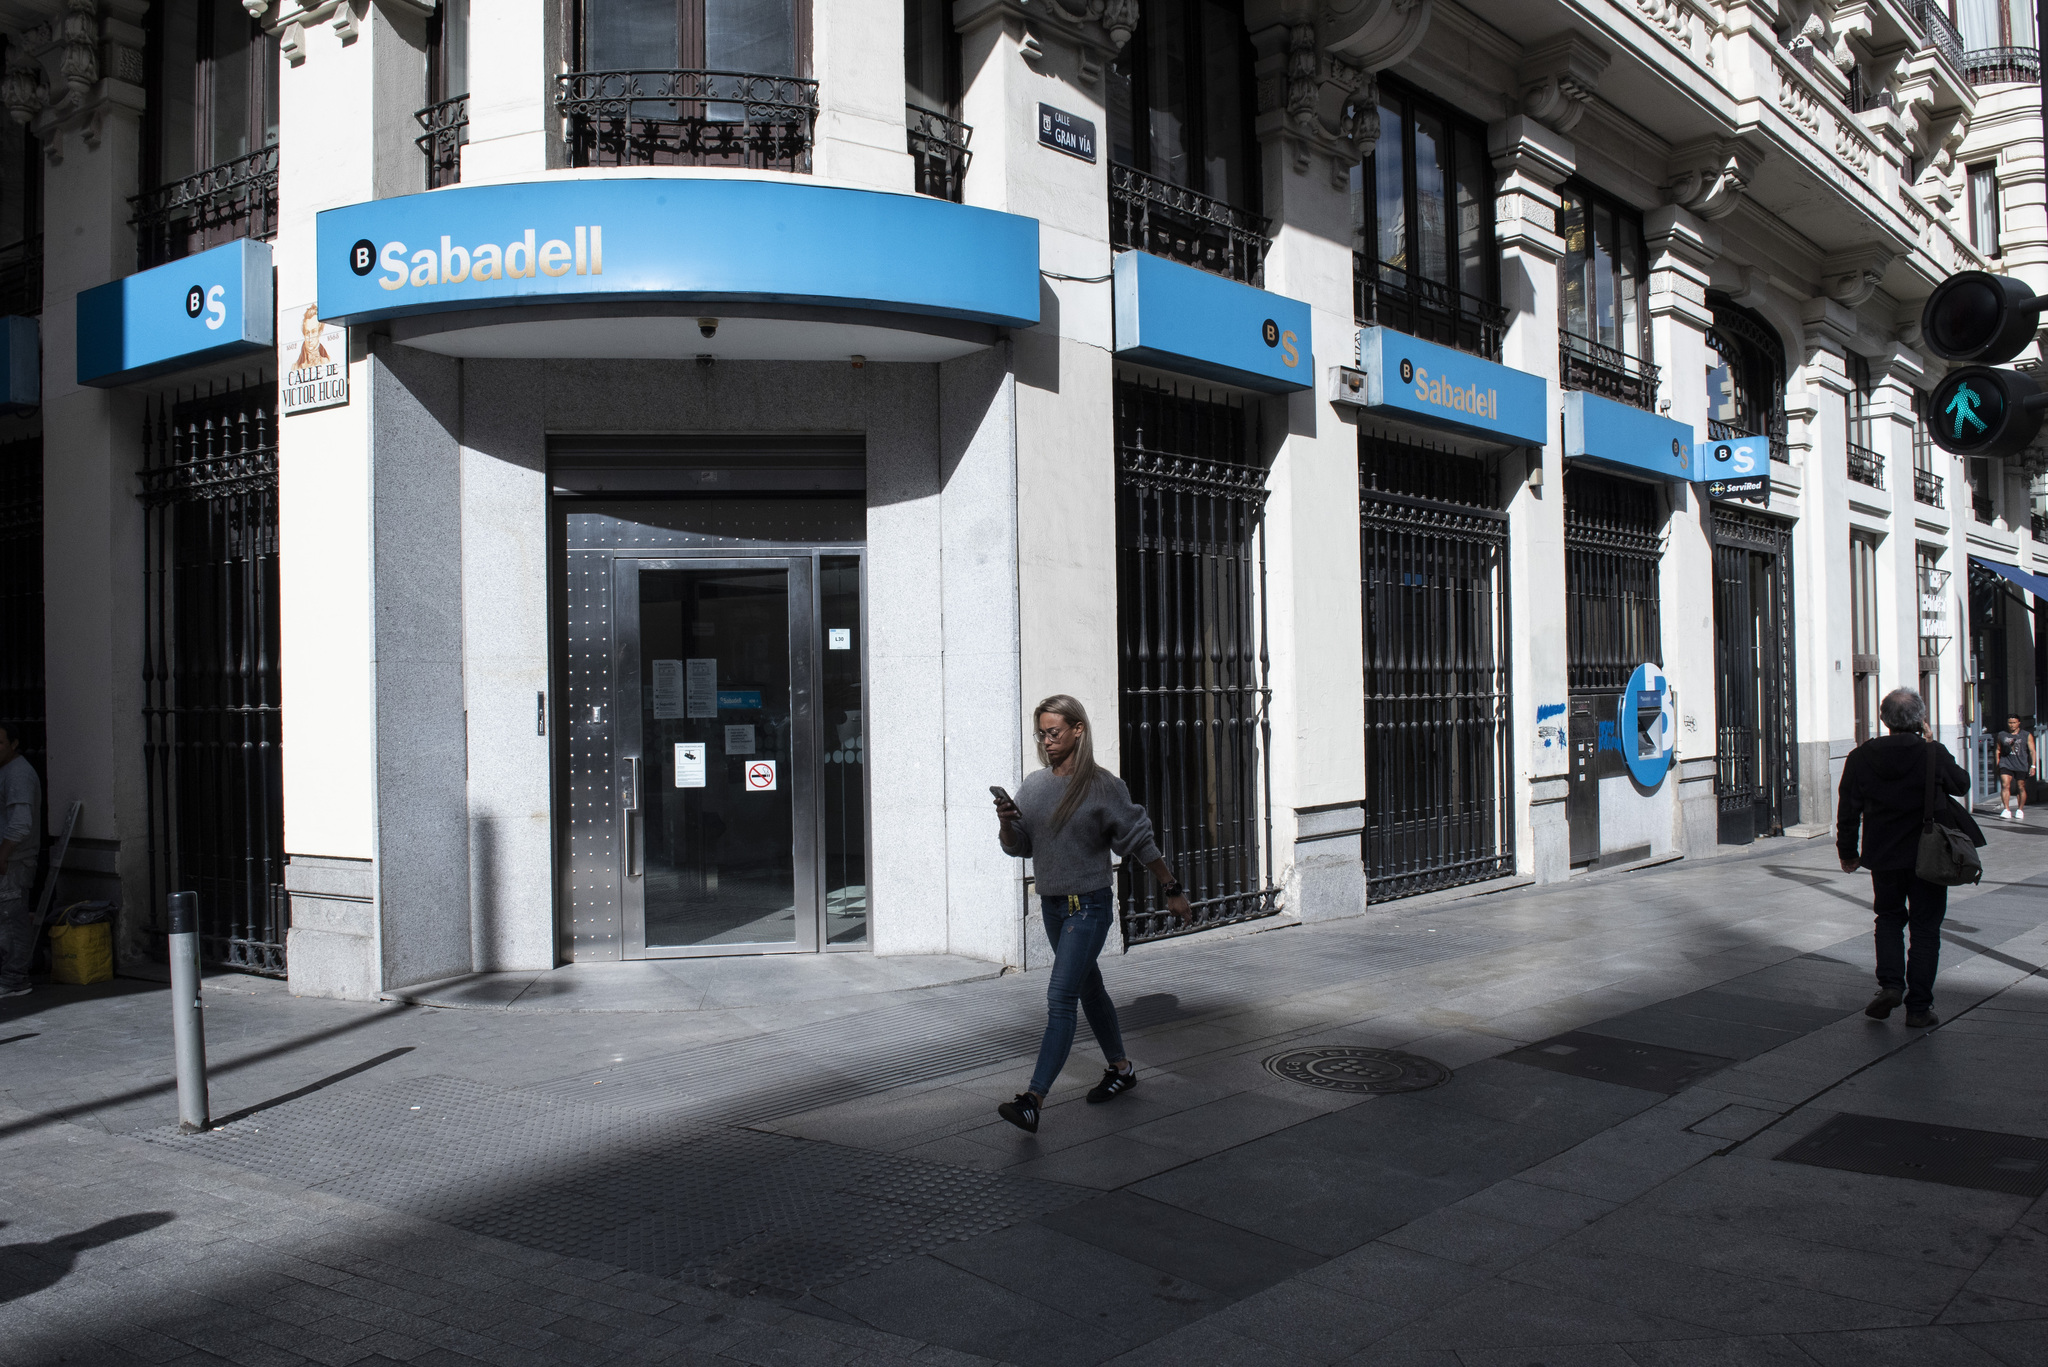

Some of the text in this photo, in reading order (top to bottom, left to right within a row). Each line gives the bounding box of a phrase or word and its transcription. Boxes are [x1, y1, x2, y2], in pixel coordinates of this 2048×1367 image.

[1054, 112, 1070, 127] CALLE
[1055, 128, 1091, 153] GRAN VÍA
[378, 225, 603, 291] Sabadell
[205, 284, 226, 330] S
[288, 363, 338, 386] CALLE DE
[282, 378, 345, 407] VICTOR HUGO
[1415, 367, 1497, 420] Sabadell
[1732, 446, 1755, 473] S
[1726, 481, 1763, 493] ServiRed
